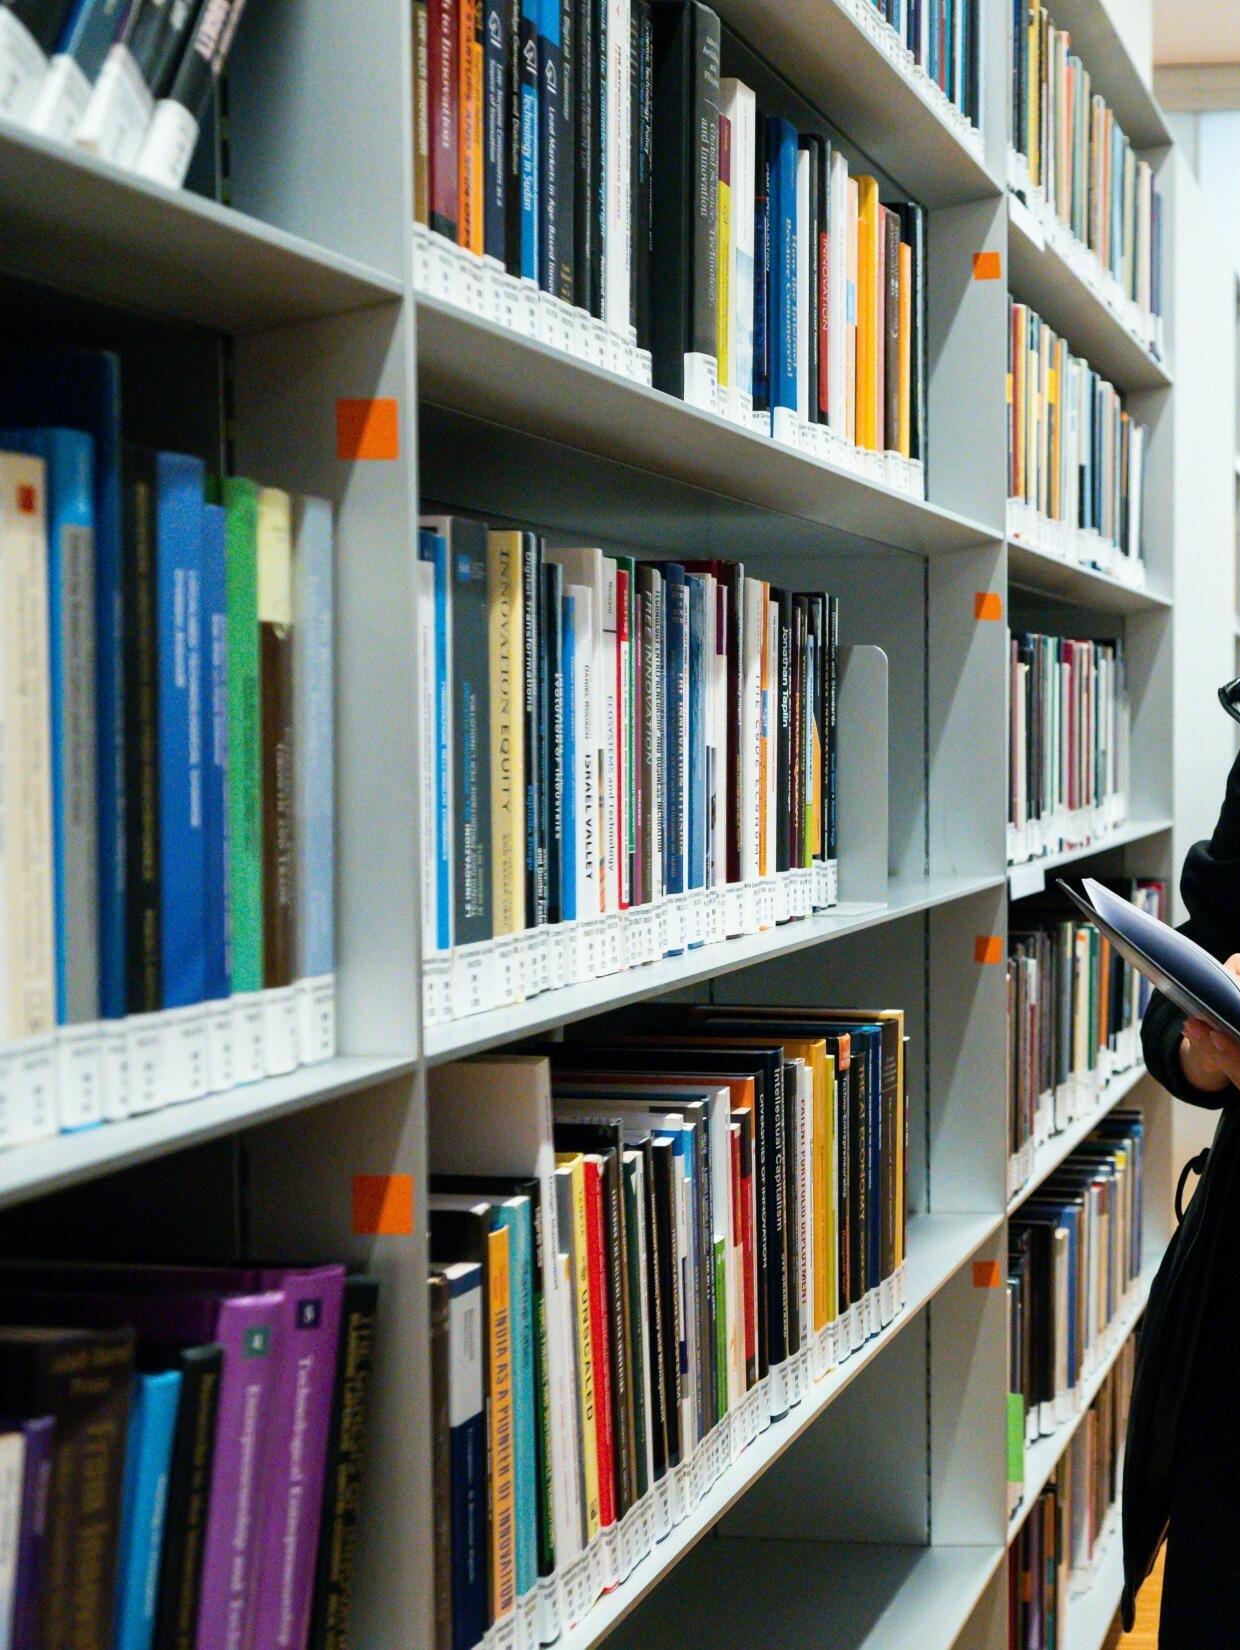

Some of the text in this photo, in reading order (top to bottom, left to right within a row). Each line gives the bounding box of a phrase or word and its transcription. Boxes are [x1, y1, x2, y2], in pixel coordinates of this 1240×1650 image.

[442, 13, 451, 149] to Innovation
[524, 94, 534, 211] Technology in Sudan
[549, 184, 555, 196] in
[700, 146, 708, 218] Innovation
[500, 550, 510, 816] INNOVATION EQUITY
[555, 746, 560, 765] OF
[465, 902, 471, 918] LE
[859, 1103, 865, 1120] AI
[761, 1167, 765, 1185] OF
[774, 1154, 782, 1232] Capitalism
[495, 1308, 508, 1357] INDIA
[581, 1288, 593, 1423] UNSCALED
[496, 1364, 508, 1386] AS
[497, 1390, 509, 1401] A
[499, 1507, 513, 1611] INNOVATION
